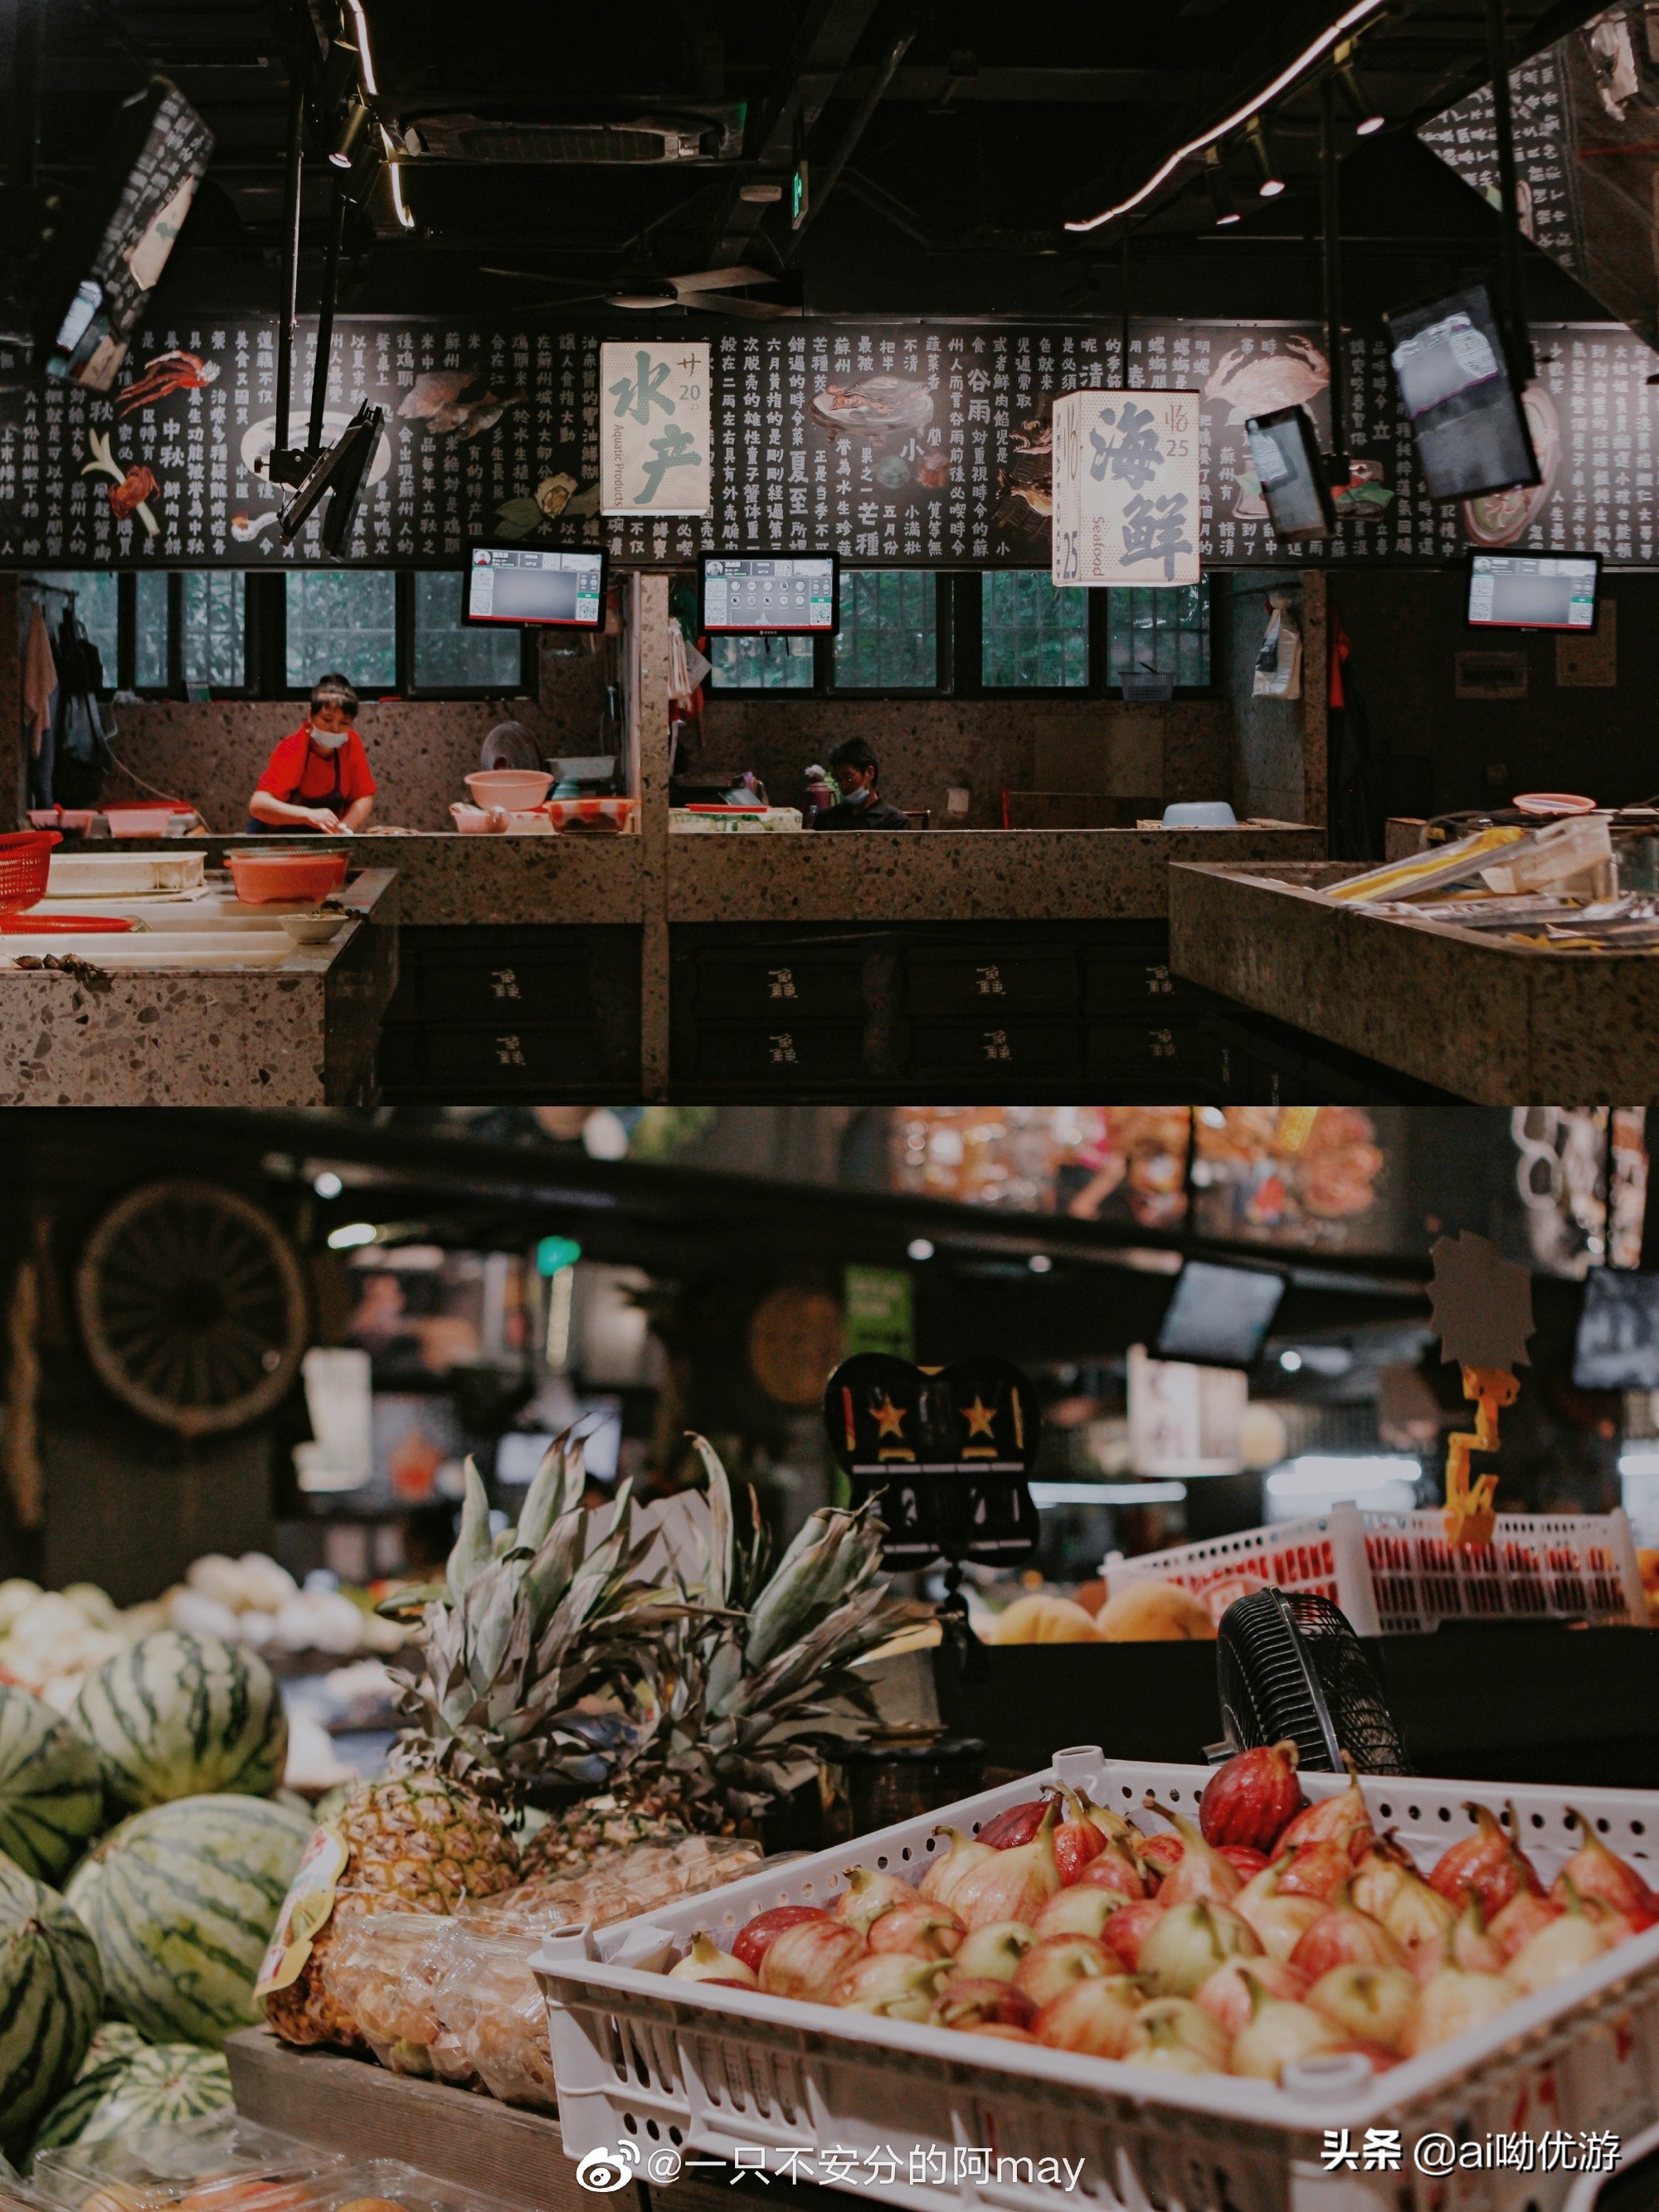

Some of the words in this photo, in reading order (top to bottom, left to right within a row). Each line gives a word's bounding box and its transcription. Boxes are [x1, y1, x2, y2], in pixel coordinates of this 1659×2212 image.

[903, 338, 919, 372] 不清
[971, 336, 986, 354] 食
[1130, 340, 1142, 354] 用
[679, 384, 701, 401] 20
[967, 368, 992, 425] 谷雨
[159, 418, 185, 469] 中秋
[607, 350, 703, 504] 水产
[611, 424, 625, 462] Aquatic
[1165, 440, 1189, 457] 25
[860, 447, 873, 493] 果之一
[899, 438, 926, 463] 小
[613, 464, 625, 506] Products
[787, 450, 809, 515] 夏至
[855, 501, 880, 557] 芒種
[883, 505, 899, 557] 五月份
[995, 542, 1010, 557] 小
[1092, 517, 1105, 576] Seafood
[1063, 531, 1078, 579] 25
